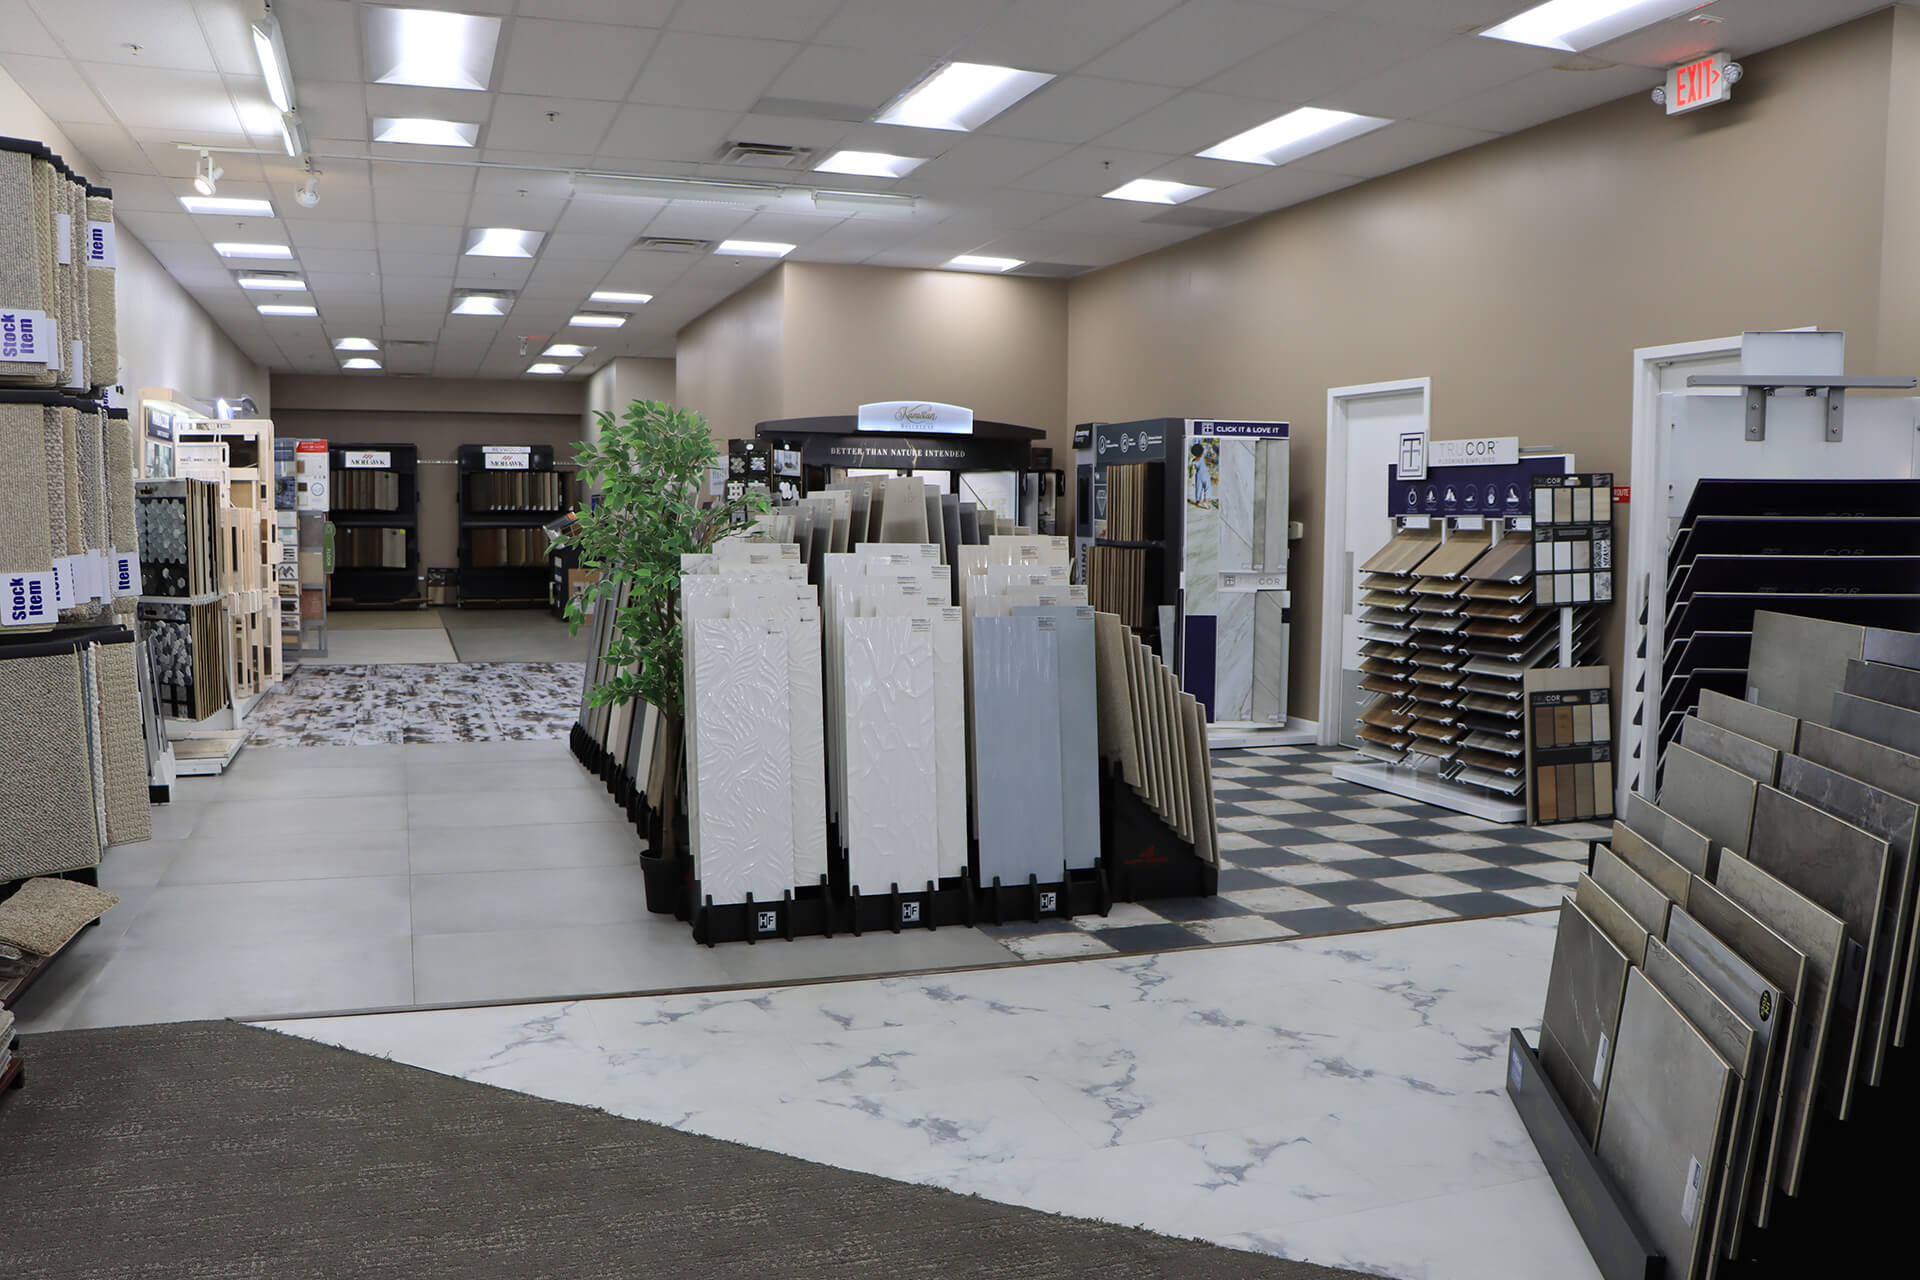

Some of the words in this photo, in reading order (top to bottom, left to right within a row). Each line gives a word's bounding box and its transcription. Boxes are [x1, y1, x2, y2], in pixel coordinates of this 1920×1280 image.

[1676, 58, 1714, 106] EXIT
[91, 228, 104, 260] Item
[1, 314, 17, 357] Stock
[20, 318, 34, 354] Item
[831, 447, 863, 456] BETTER
[866, 447, 888, 456] THAN
[890, 448, 923, 457] NATURE
[925, 449, 966, 458] INTENDED
[118, 559, 131, 590] Item
[10, 577, 27, 620] Stock
[29, 580, 43, 616] Item
